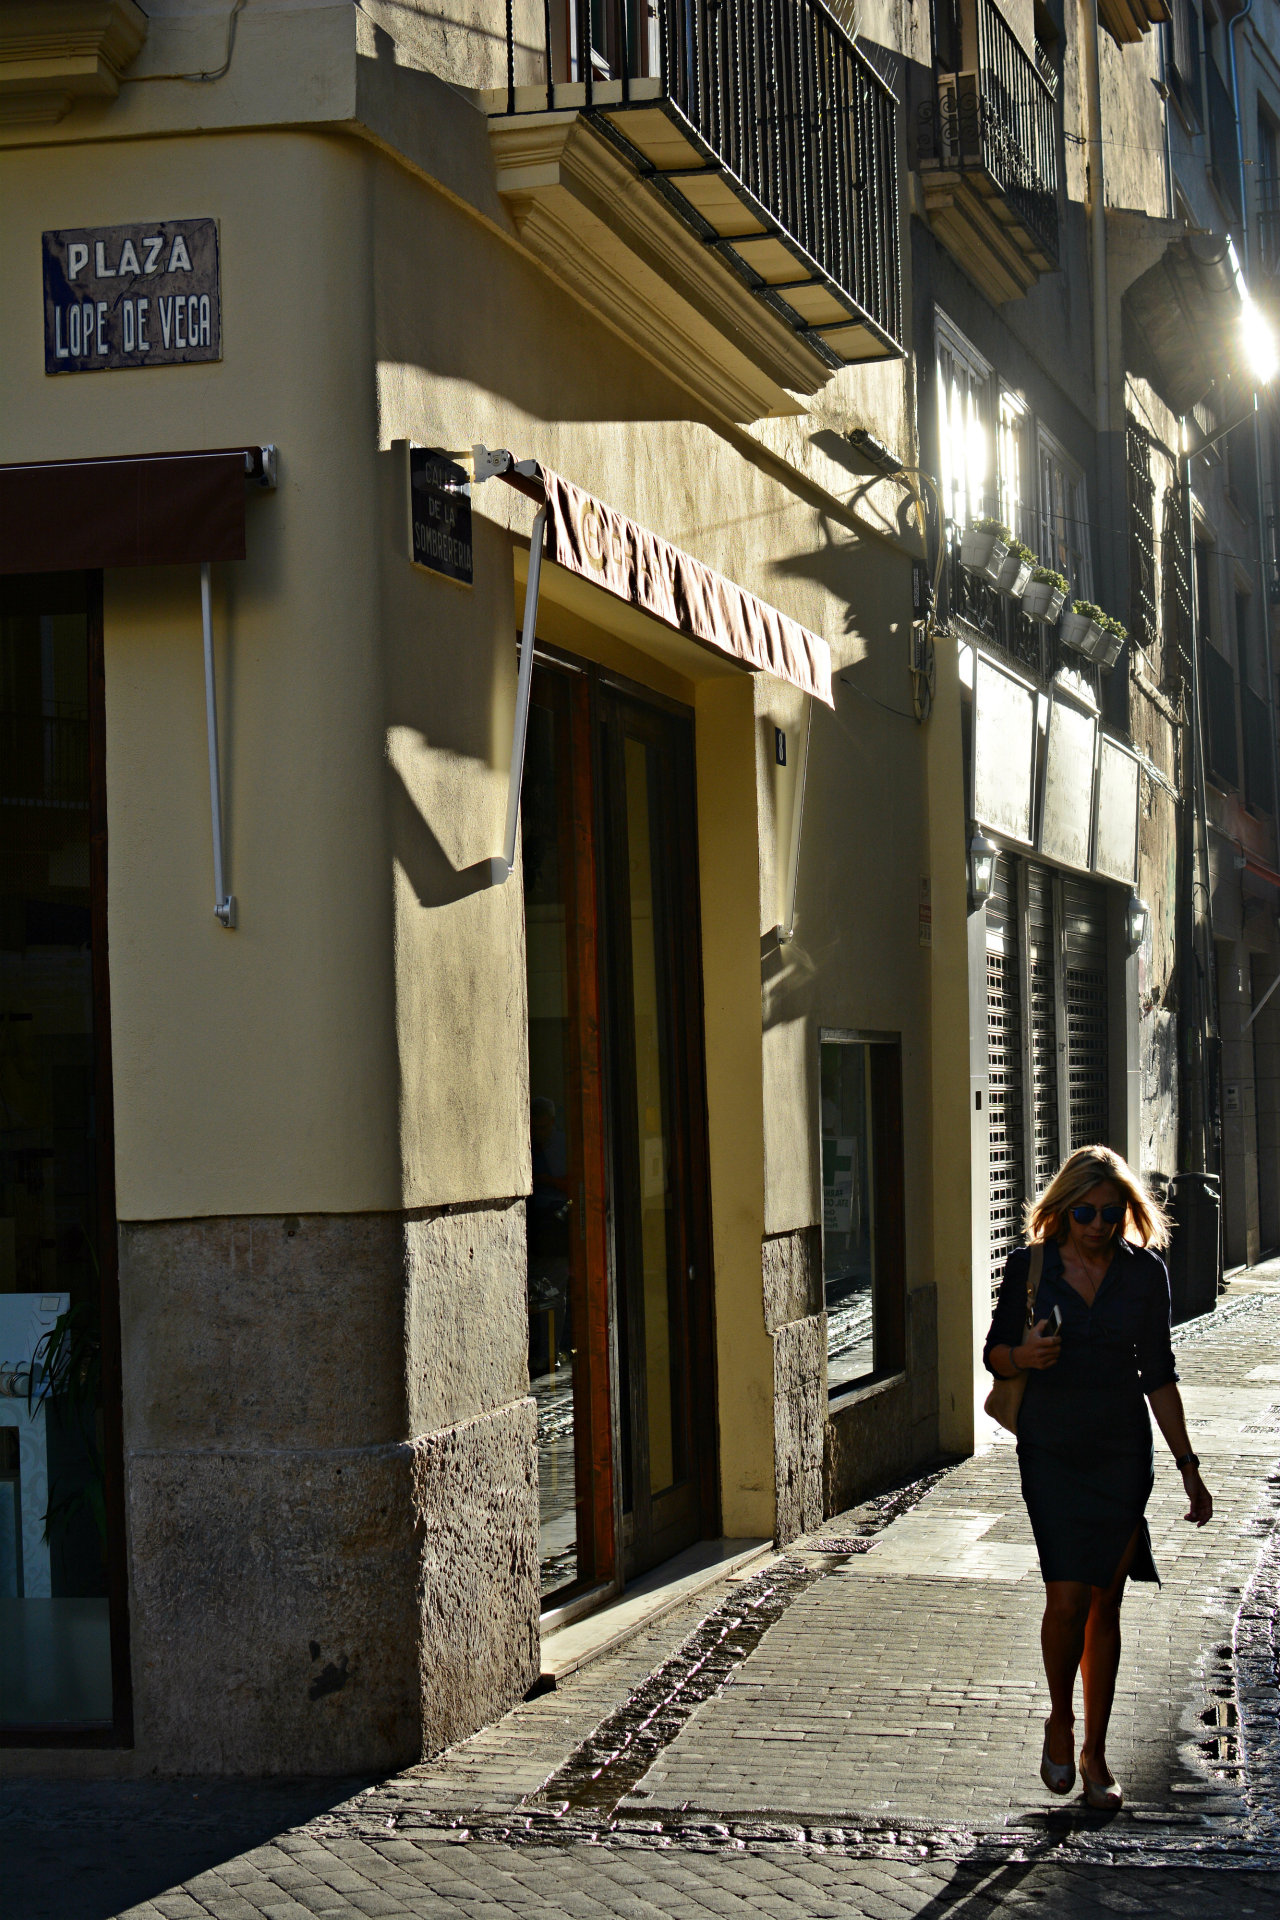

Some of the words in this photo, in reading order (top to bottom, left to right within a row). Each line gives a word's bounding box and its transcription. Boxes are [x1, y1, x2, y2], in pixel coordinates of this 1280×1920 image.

[67, 235, 193, 281] PLAZA
[55, 302, 109, 358] LOPE
[123, 298, 150, 353] DE
[158, 294, 211, 349] VEGA
[428, 496, 441, 520] DE
[444, 503, 456, 528] LA
